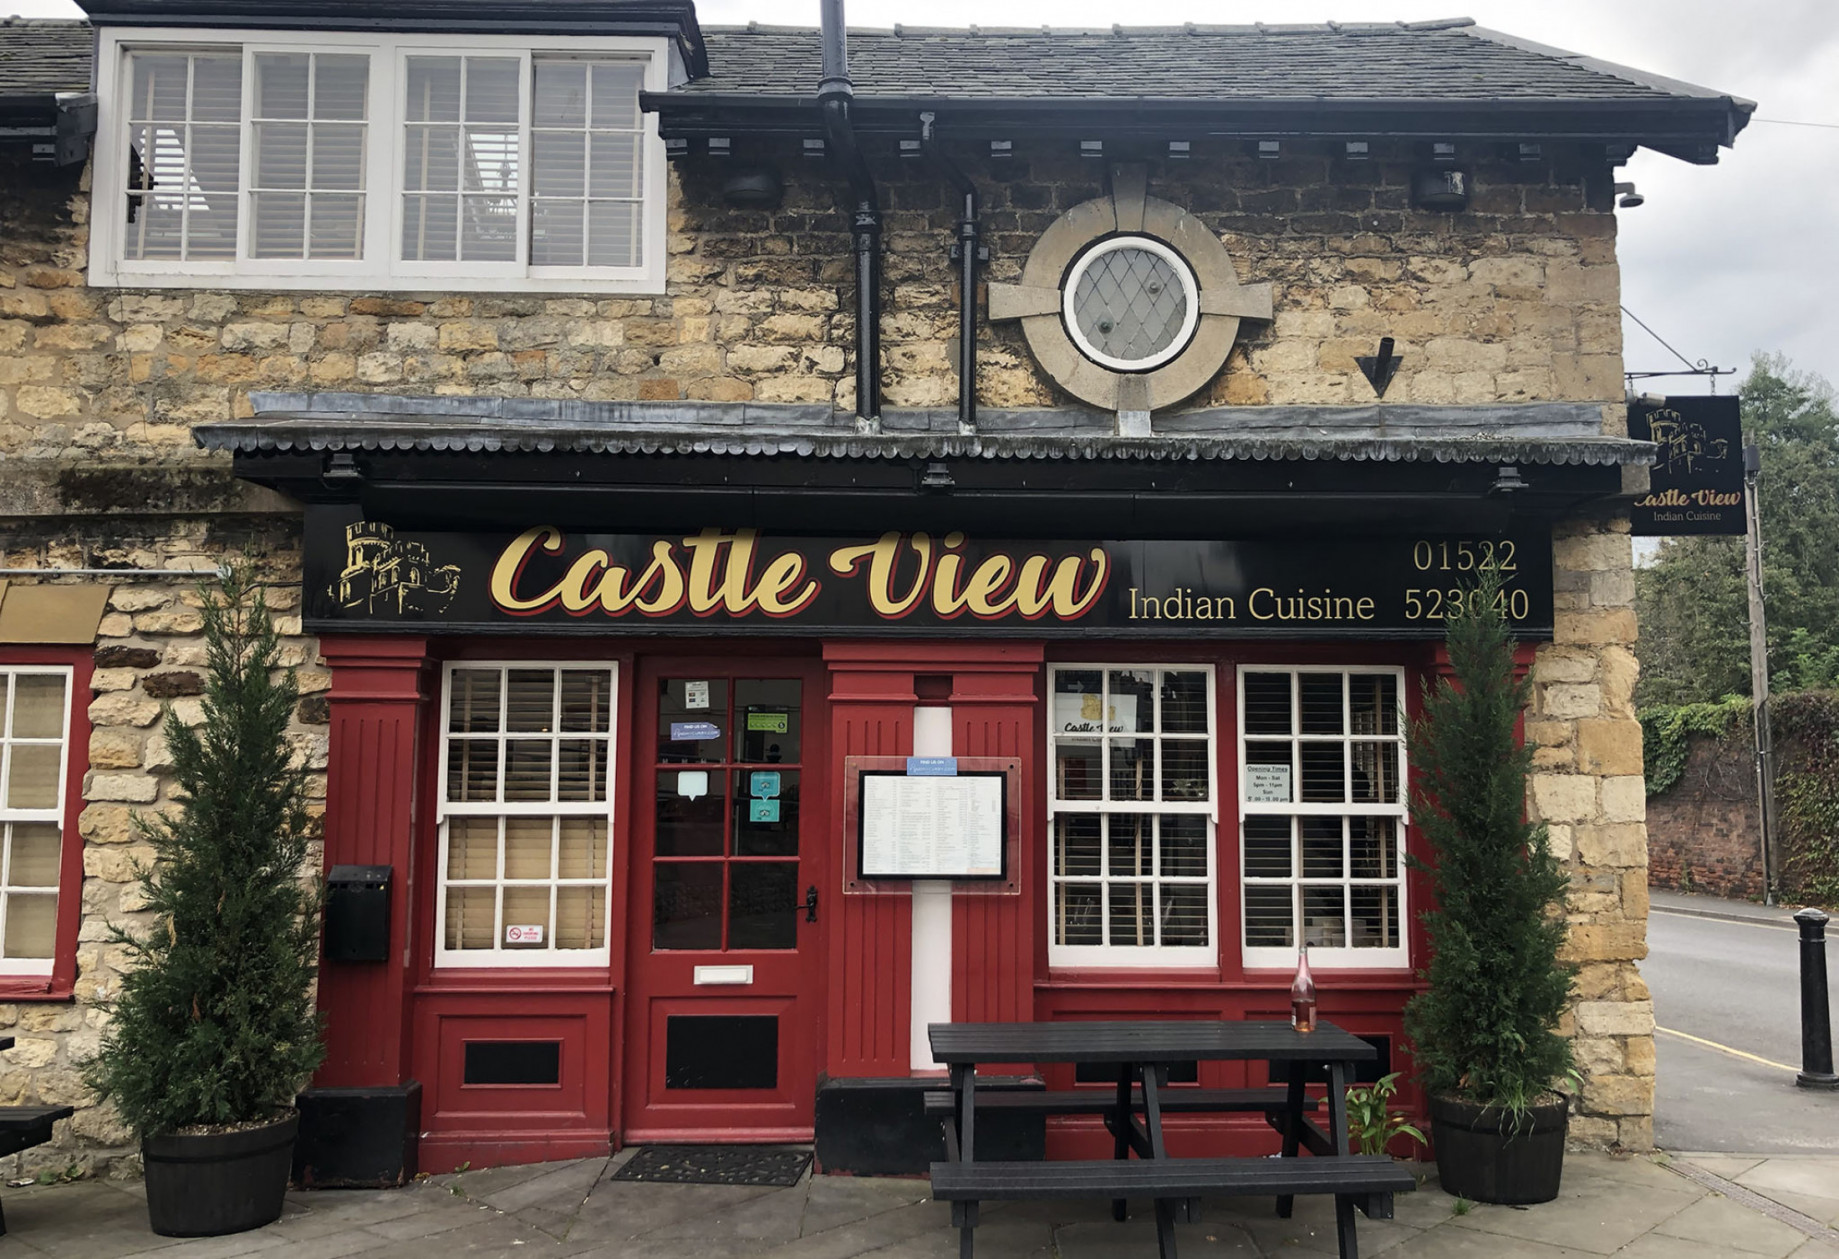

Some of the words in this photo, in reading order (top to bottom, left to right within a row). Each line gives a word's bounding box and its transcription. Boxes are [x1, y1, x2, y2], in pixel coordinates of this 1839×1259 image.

[1634, 489, 1690, 507] astle
[1691, 489, 1741, 506] View
[1653, 511, 1684, 521] Indian
[1685, 510, 1722, 521] Cuisine
[1413, 540, 1517, 571] 01522
[488, 524, 822, 619] Castle
[826, 530, 1112, 621] View
[1128, 587, 1237, 620] Indian
[1248, 587, 1376, 621] Cuisine
[1064, 722, 1095, 733] Castle
